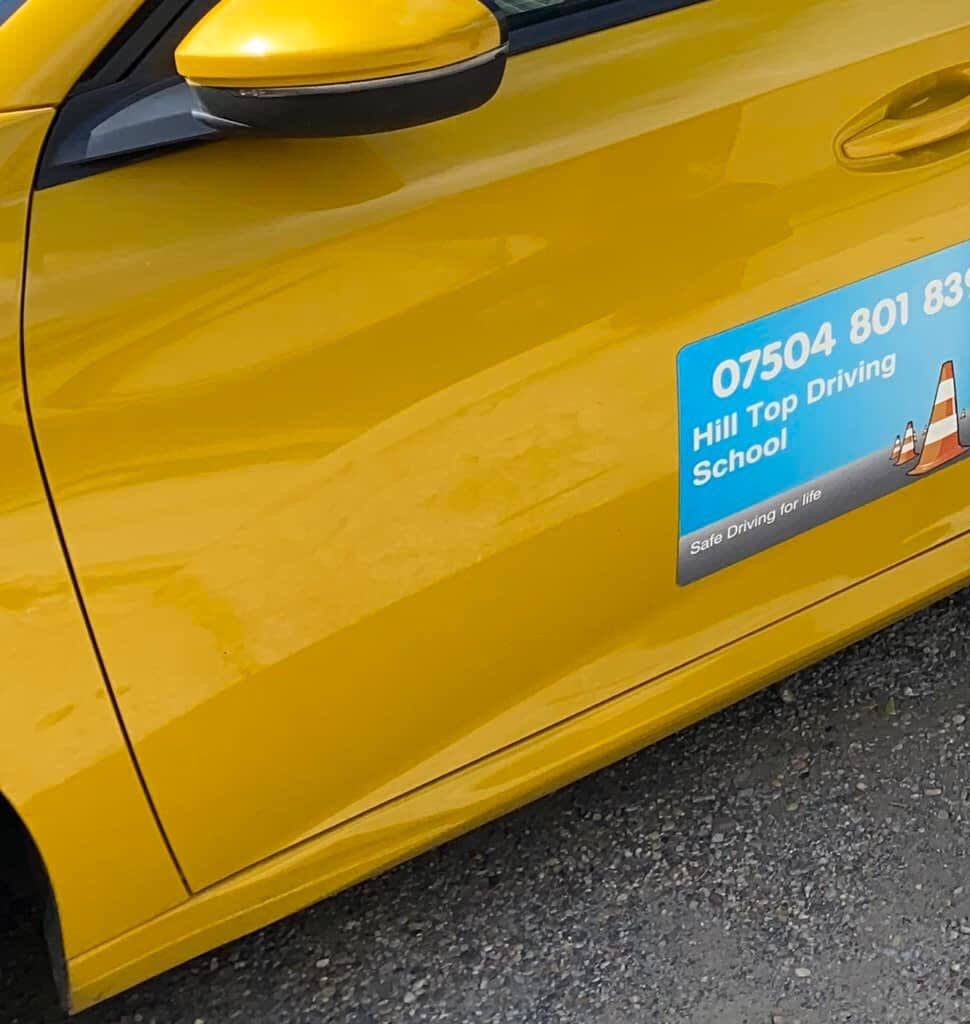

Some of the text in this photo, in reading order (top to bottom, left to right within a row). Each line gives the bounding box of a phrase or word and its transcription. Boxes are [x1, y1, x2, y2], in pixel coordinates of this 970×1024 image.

[712, 321, 836, 398] 07504
[850, 292, 909, 344] 801
[693, 353, 896, 451] Hill Top Driving
[692, 428, 787, 486] School
[690, 488, 822, 555] Safe Driving for life
